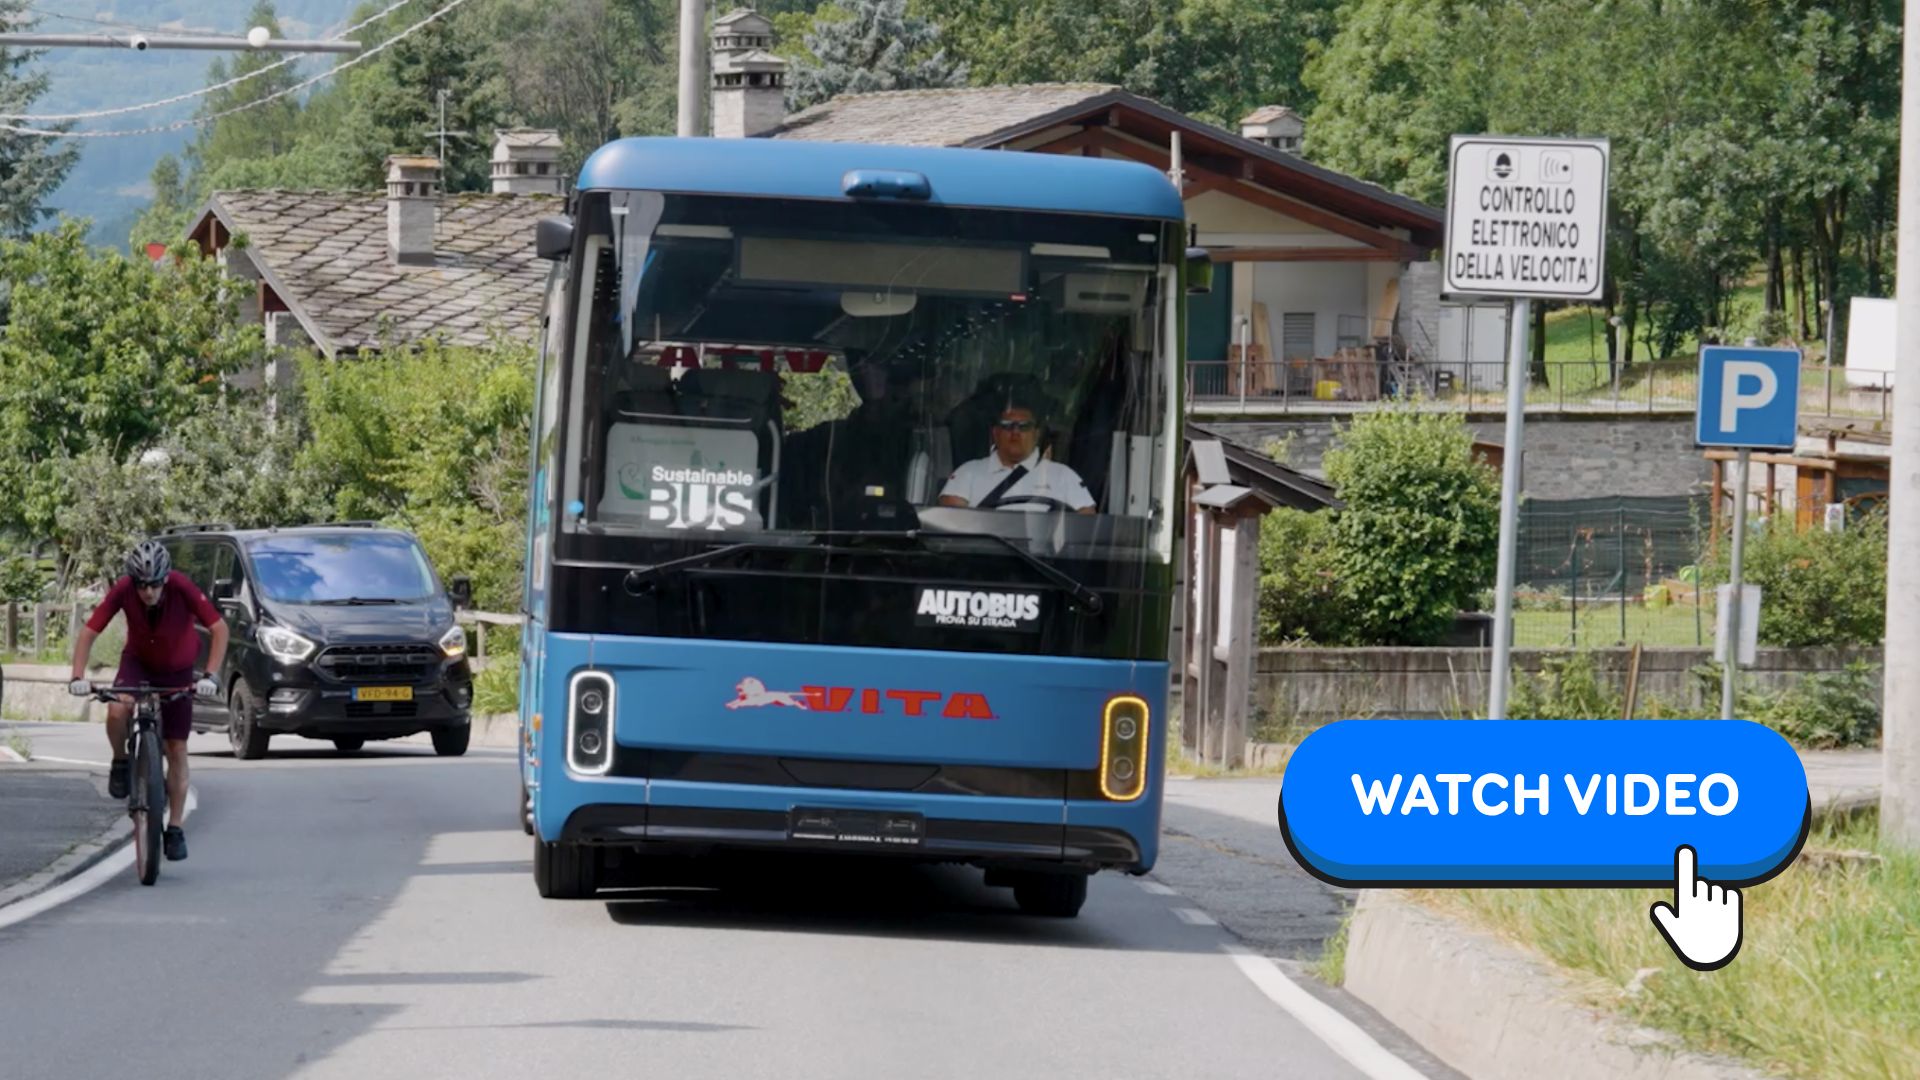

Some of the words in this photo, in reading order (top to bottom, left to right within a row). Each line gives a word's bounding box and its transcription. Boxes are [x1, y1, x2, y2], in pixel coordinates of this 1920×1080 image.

[1480, 185, 1575, 214] CONTROLLO
[1472, 219, 1579, 248] ELETTRONICO
[1456, 252, 1504, 281] DELLA
[1719, 360, 1778, 433] P
[652, 465, 754, 486] Sustainable
[649, 482, 754, 531] BUS
[917, 589, 1039, 620] AUTOBUS
[935, 615, 966, 625] PROVA
[967, 616, 981, 626] SU
[981, 617, 1017, 627] STRADA
